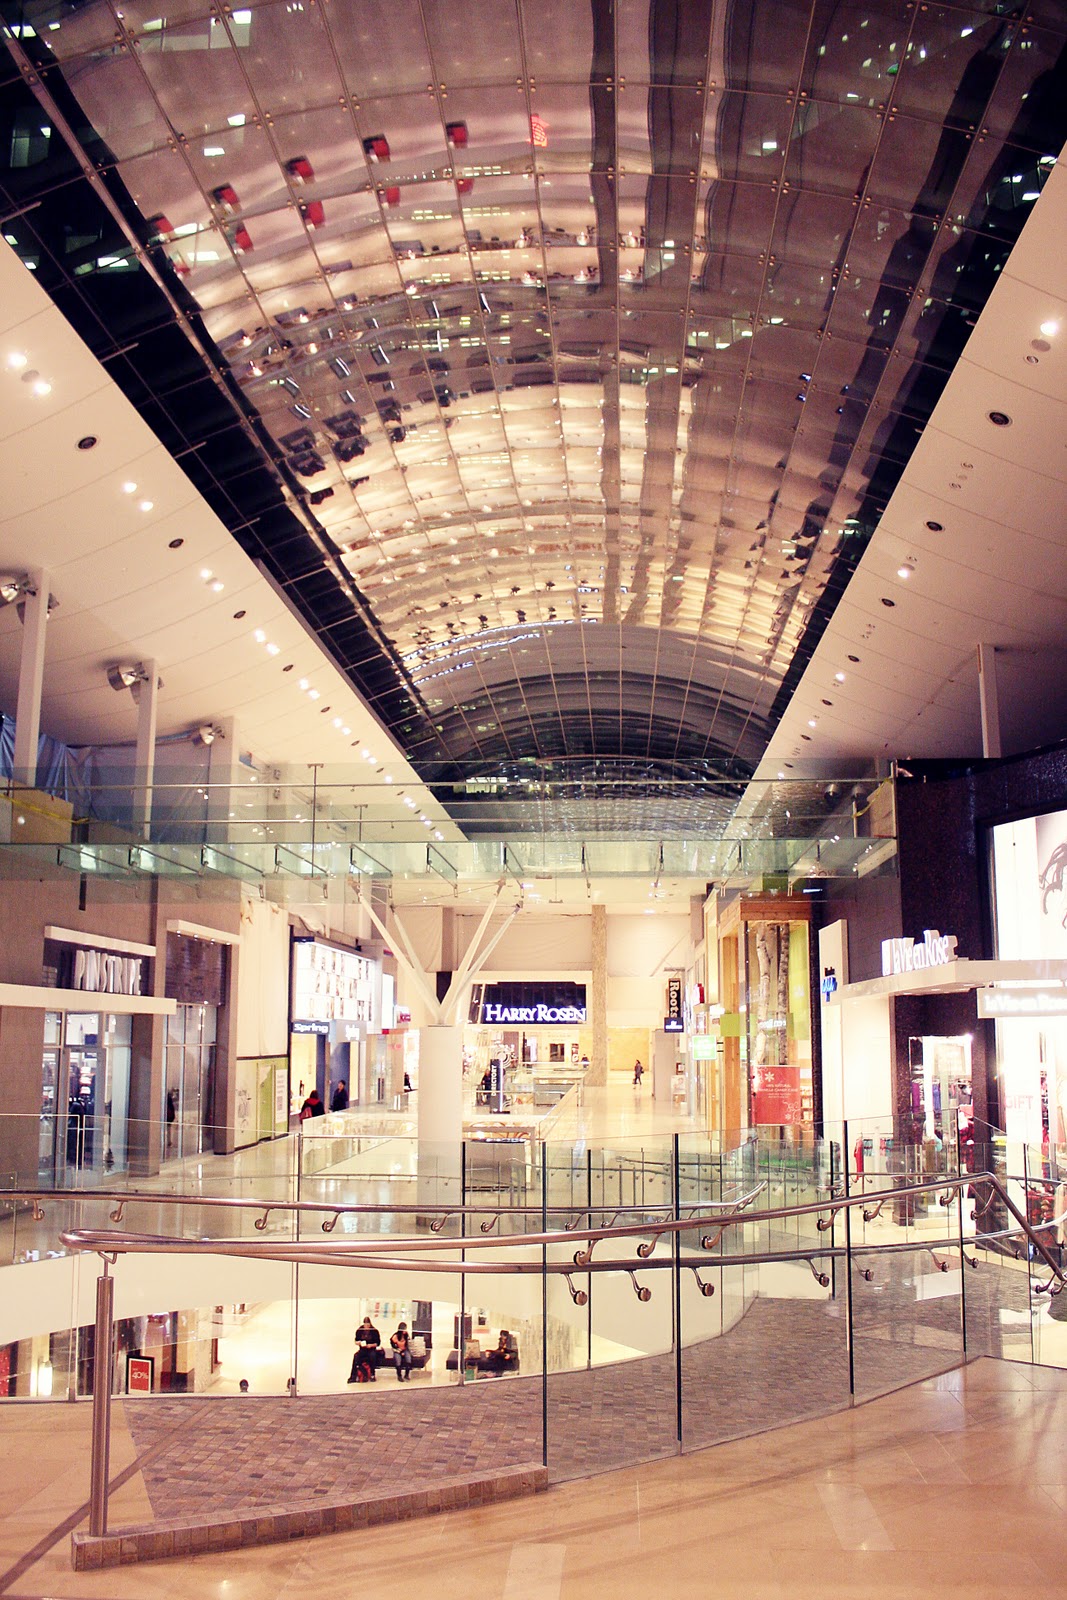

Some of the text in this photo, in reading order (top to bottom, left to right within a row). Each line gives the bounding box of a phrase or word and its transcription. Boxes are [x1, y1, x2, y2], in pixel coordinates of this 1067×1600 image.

[669, 981, 680, 1018] Roots
[485, 1004, 587, 1022] HARRY ROSEN
[294, 1023, 329, 1034] Spring
